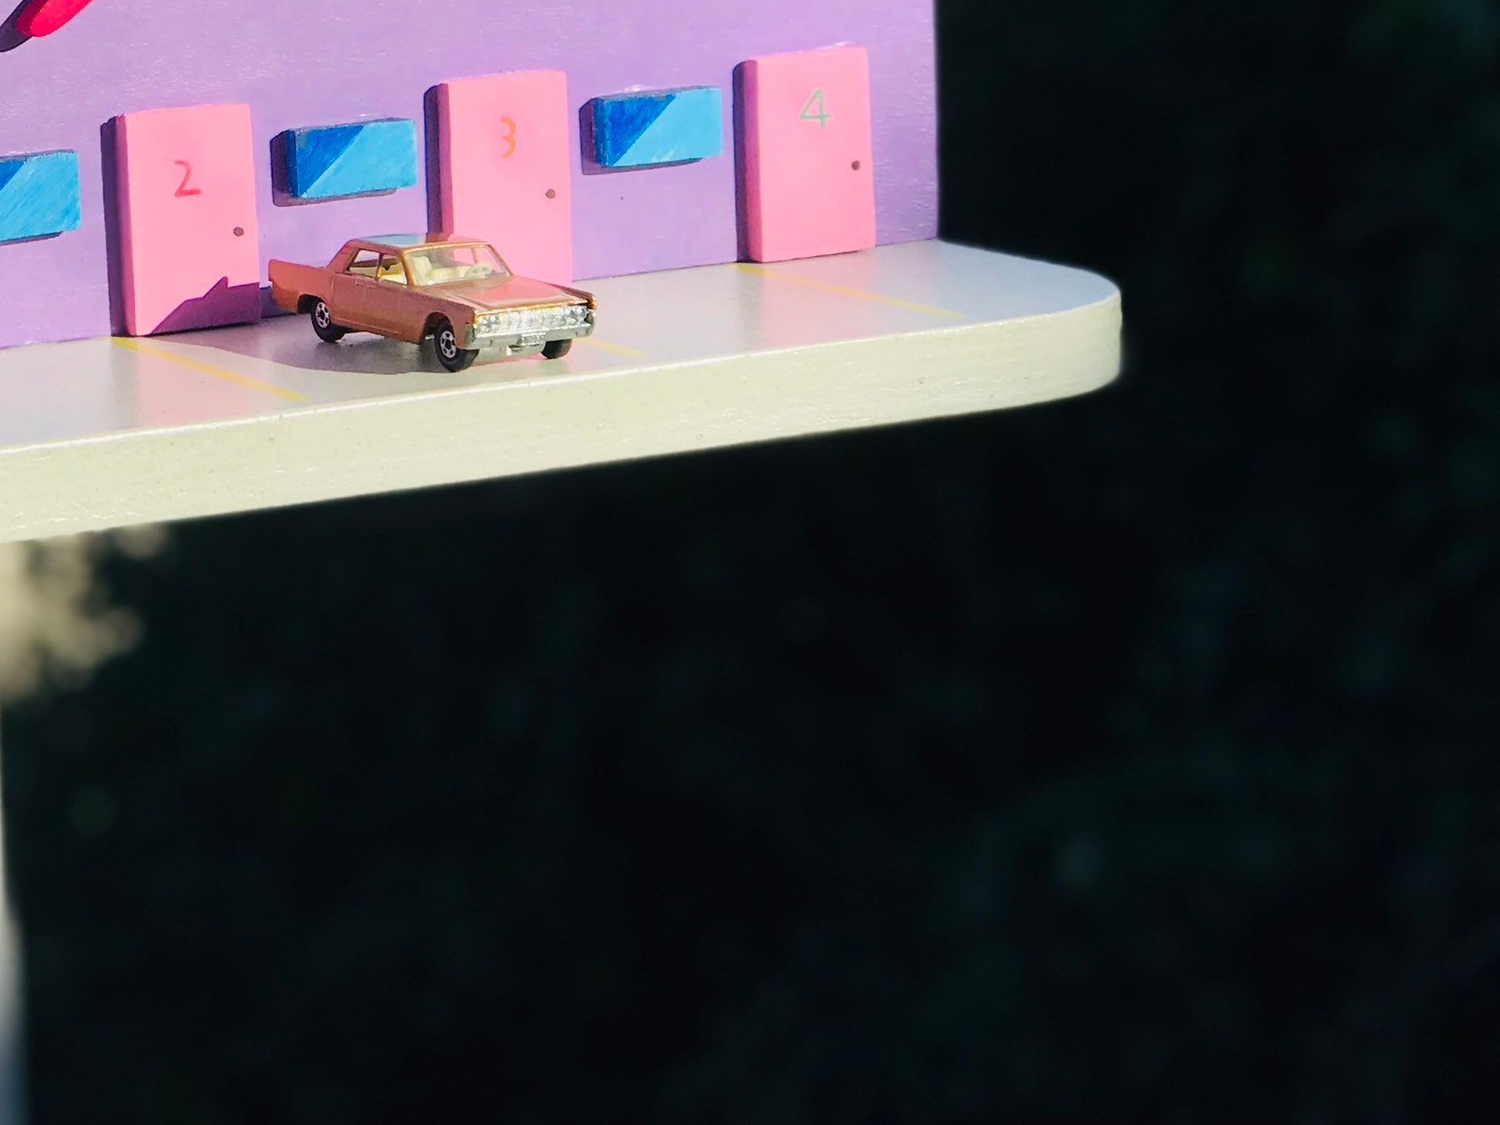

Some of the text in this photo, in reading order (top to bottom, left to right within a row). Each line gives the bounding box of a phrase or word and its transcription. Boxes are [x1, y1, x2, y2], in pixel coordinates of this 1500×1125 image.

[799, 88, 833, 128] 4
[500, 116, 517, 159] 3
[174, 159, 202, 198] 2
